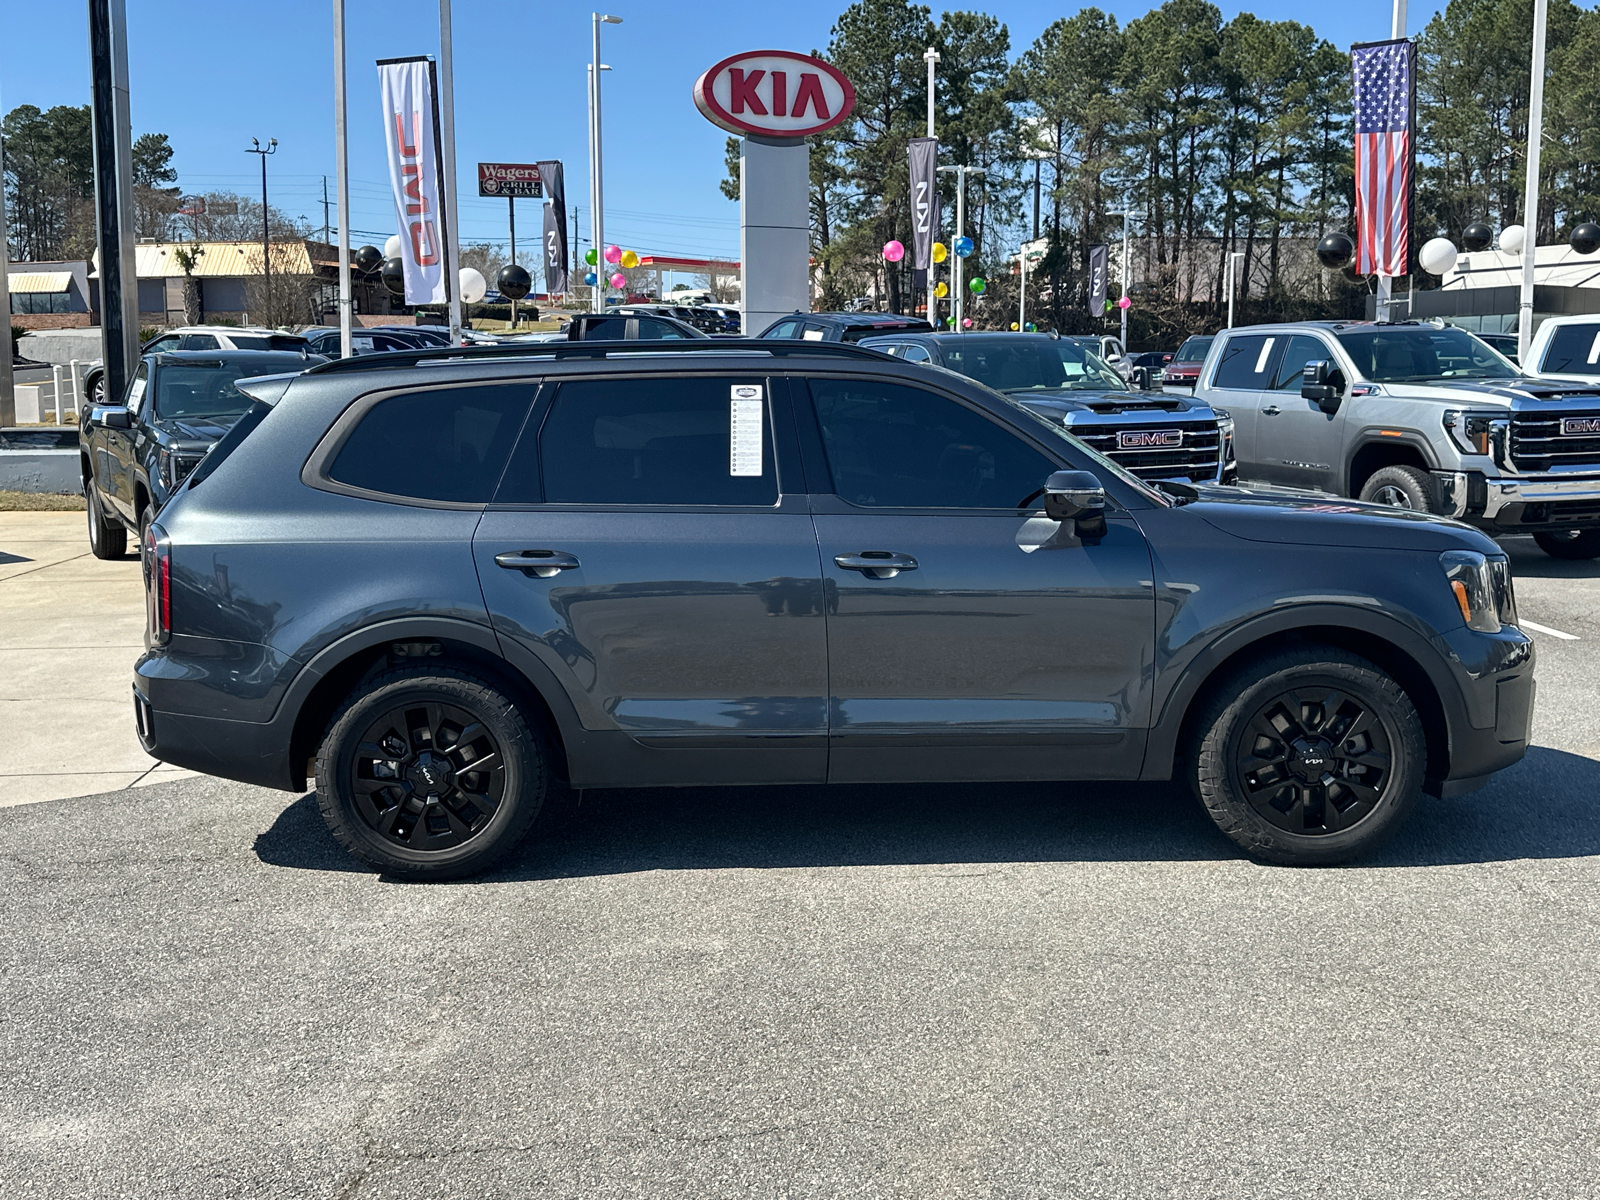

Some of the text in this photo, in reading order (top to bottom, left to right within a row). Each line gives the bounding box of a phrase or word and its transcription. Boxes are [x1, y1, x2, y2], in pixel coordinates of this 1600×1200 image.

[728, 68, 830, 119] KIA
[481, 165, 539, 181] Wagers
[1566, 419, 1600, 432] GM
[1122, 431, 1181, 446] GMC
